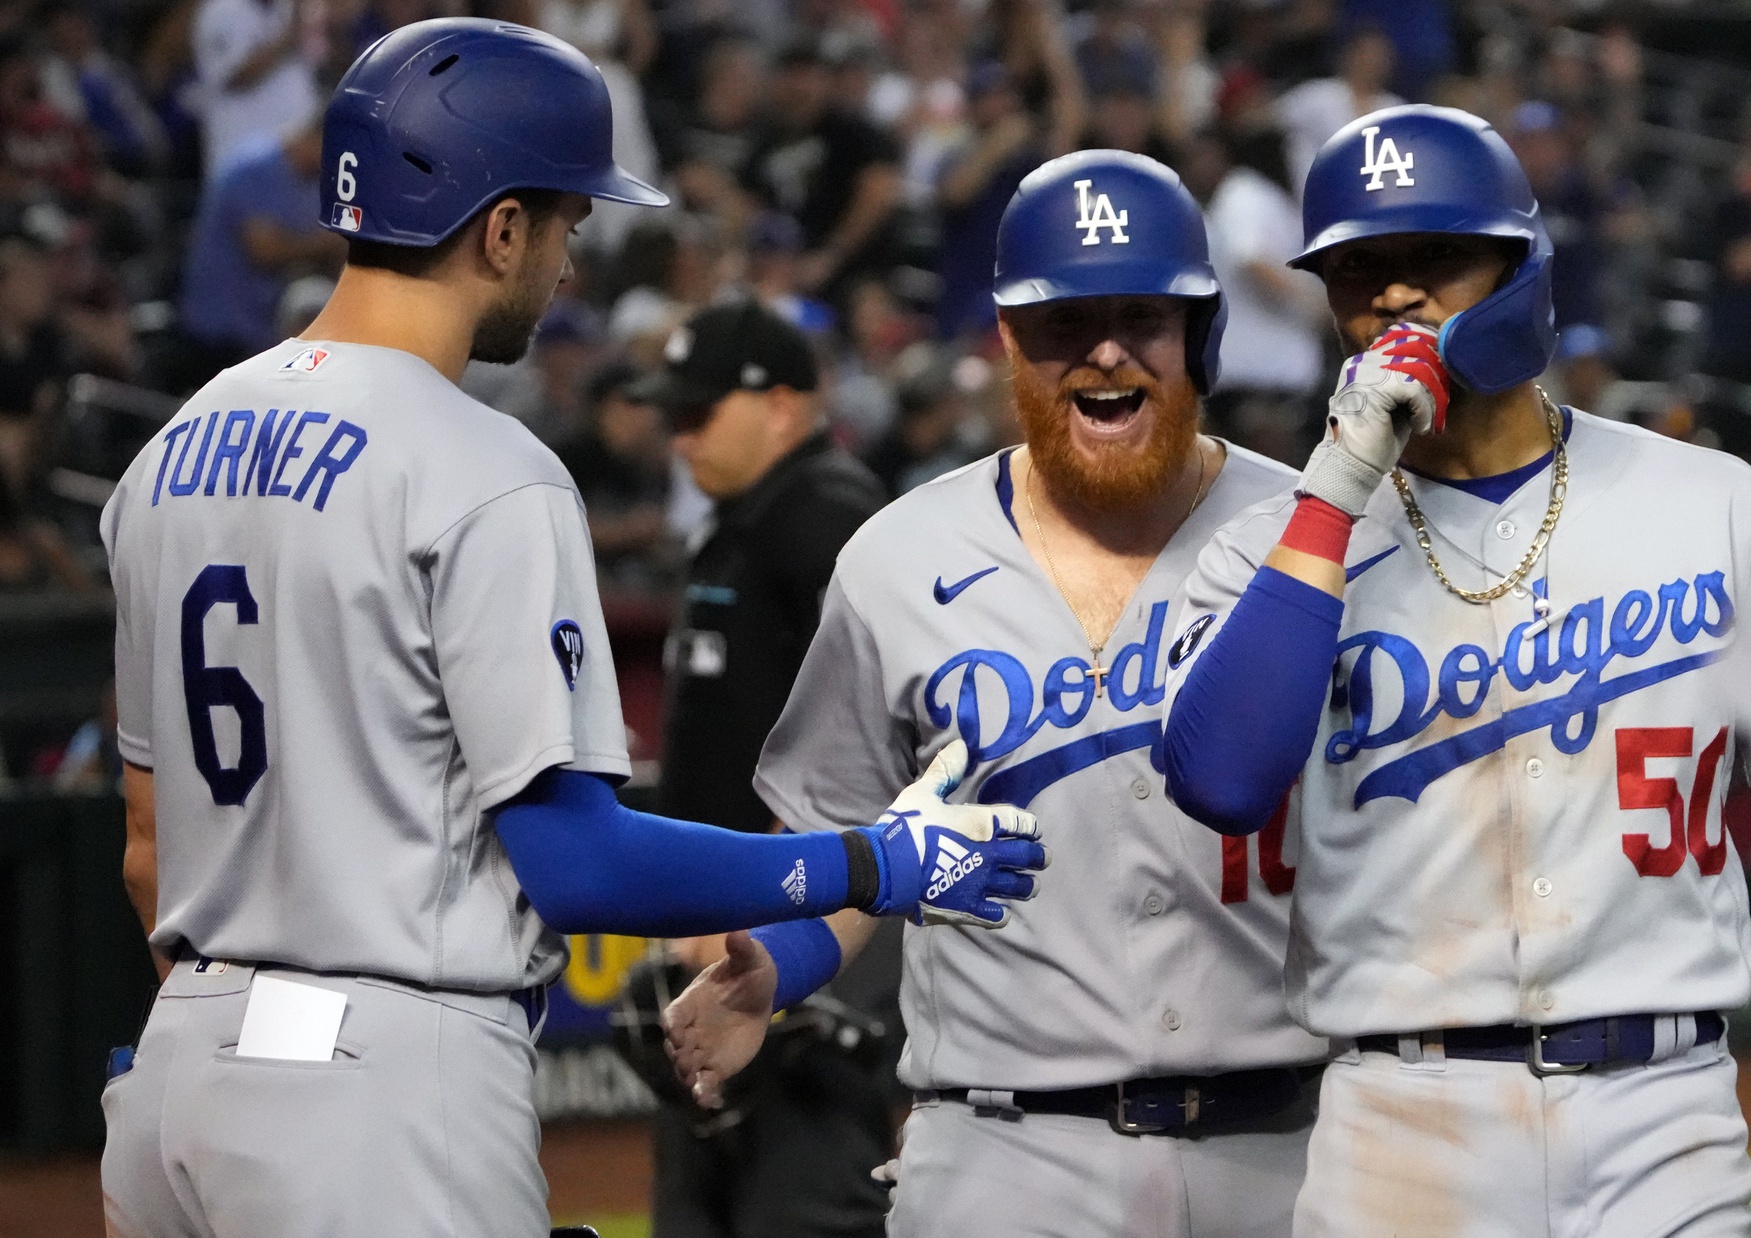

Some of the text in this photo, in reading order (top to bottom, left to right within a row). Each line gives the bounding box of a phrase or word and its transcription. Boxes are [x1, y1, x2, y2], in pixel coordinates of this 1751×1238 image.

[336, 151, 359, 202] 6
[1360, 125, 1415, 191] LA
[1073, 178, 1130, 245] LA
[151, 408, 368, 513] TURNER
[180, 563, 268, 807] 6
[924, 599, 1169, 778] Dod
[1325, 569, 1735, 765] Dodgers
[1615, 725, 1730, 878] 50
[794, 857, 807, 906] adidas
[925, 851, 984, 900] adidas
